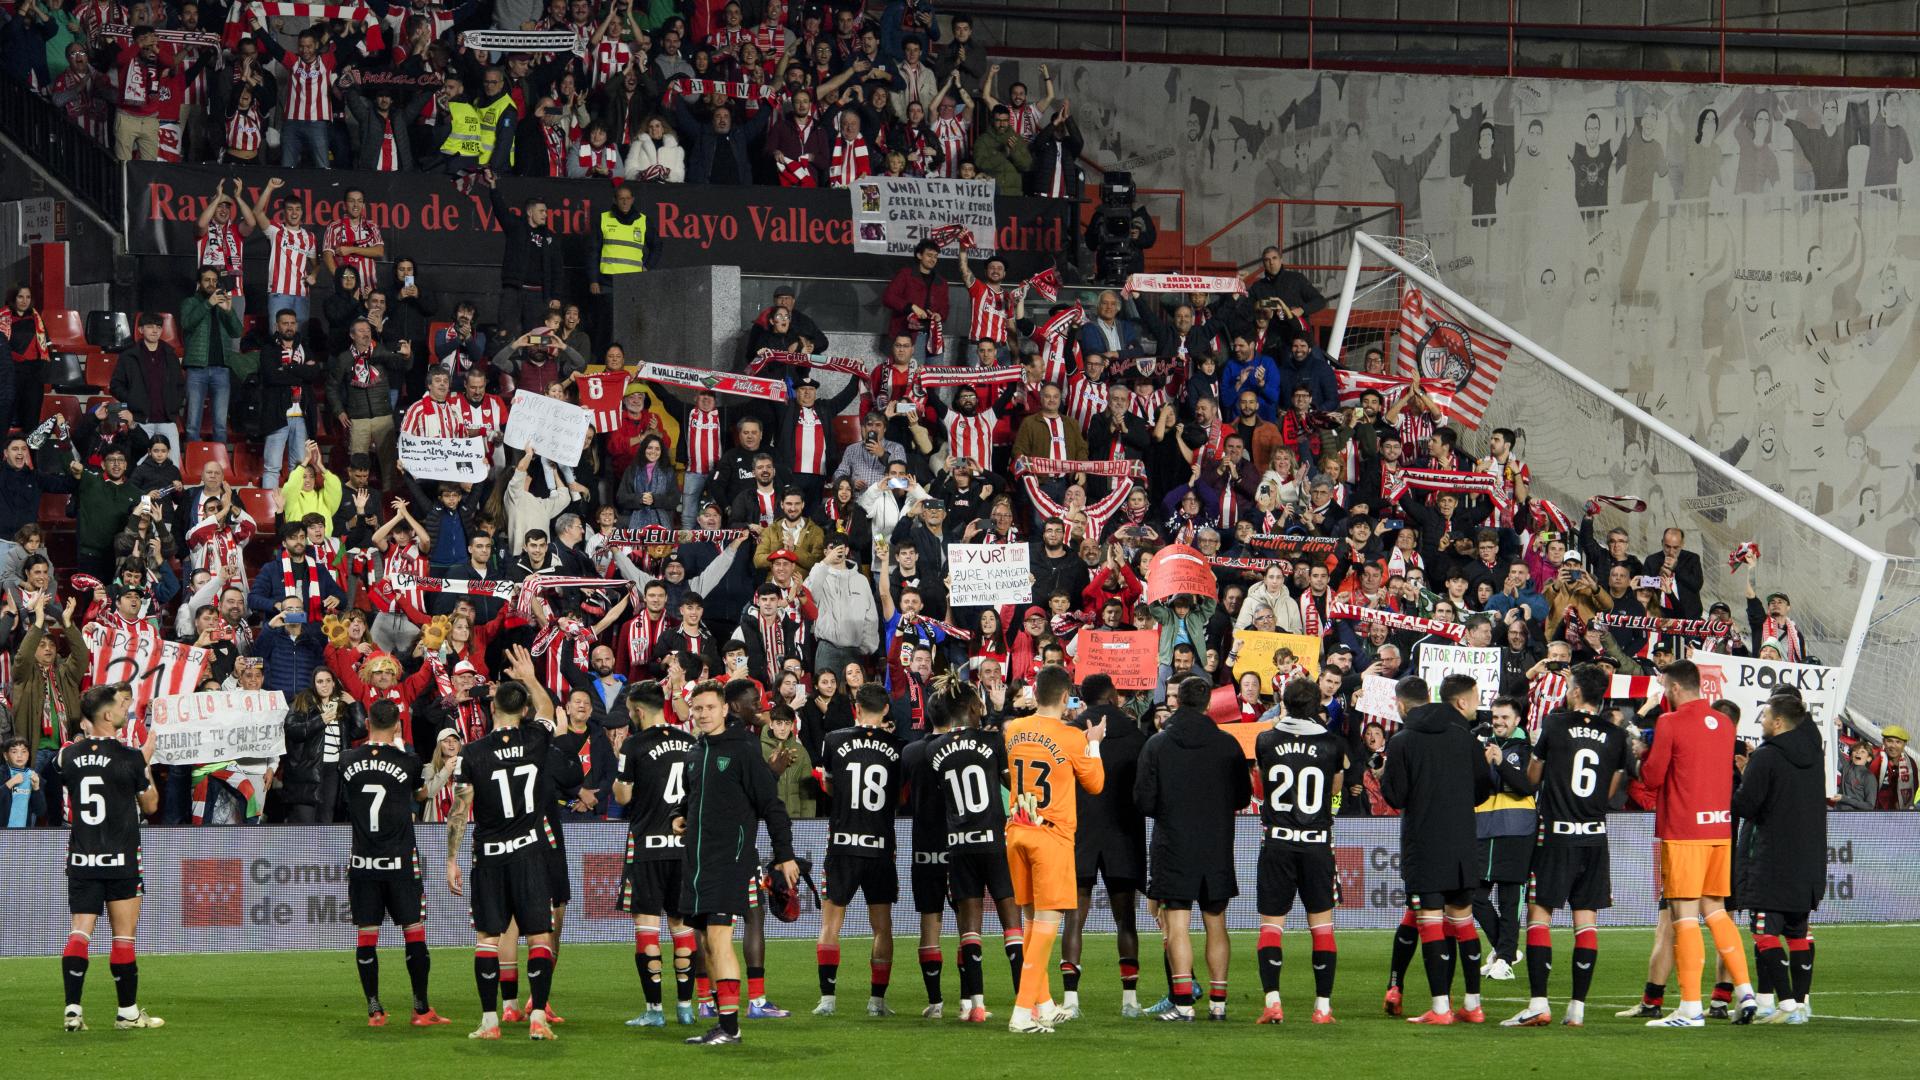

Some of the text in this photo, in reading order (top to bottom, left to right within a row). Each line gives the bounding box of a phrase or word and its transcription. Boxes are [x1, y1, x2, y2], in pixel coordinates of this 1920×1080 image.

[927, 182, 950, 194] ETA
[149, 183, 237, 223] Ra
[421, 194, 459, 231] de
[469, 194, 591, 234] Mrid
[889, 209, 925, 221] GARA
[656, 202, 1062, 252] Rayo Valleca drid
[1759, 327, 1777, 341] RAYO
[652, 366, 699, 382] R.VALLECANO
[588, 377, 603, 400] 8
[1764, 382, 1781, 396] RAYO
[1036, 458, 1082, 473] ATHLETIC
[1094, 461, 1126, 475] BILBAO
[951, 582, 991, 594] EMATEN
[93, 628, 149, 657] ANDER
[1422, 646, 1499, 664] AITOR PAREDES
[1703, 680, 1716, 693] 20
[1754, 700, 1824, 726] ZE
[210, 730, 224, 740] TU
[1568, 727, 1607, 744] VESGA
[166, 750, 199, 761] OSCAR
[214, 748, 224, 758] DE
[495, 746, 524, 761] YURI
[837, 738, 899, 762] DE MARCOS
[932, 739, 993, 772] WILLIAMS JR
[1275, 742, 1318, 758] UNAI G.
[343, 759, 408, 784] BERENGUER
[1571, 748, 1600, 798] 6
[490, 763, 538, 819] 17
[663, 762, 686, 804] 4
[846, 762, 888, 812] 18
[945, 764, 989, 817] 10
[1014, 758, 1051, 809] 13
[1268, 764, 1325, 815] 20
[80, 776, 106, 825] 5
[361, 784, 387, 832] 7
[1696, 810, 1731, 825] DIG
[1271, 826, 1327, 843] DIGI
[1553, 820, 1606, 835] DIGI
[484, 829, 538, 857] DIGI
[833, 832, 885, 849] DIGI
[948, 830, 994, 847] DIGI
[71, 853, 125, 867] DIGI
[352, 854, 402, 870] DIGI
[1371, 882, 1406, 909] de
[251, 895, 294, 926] de
